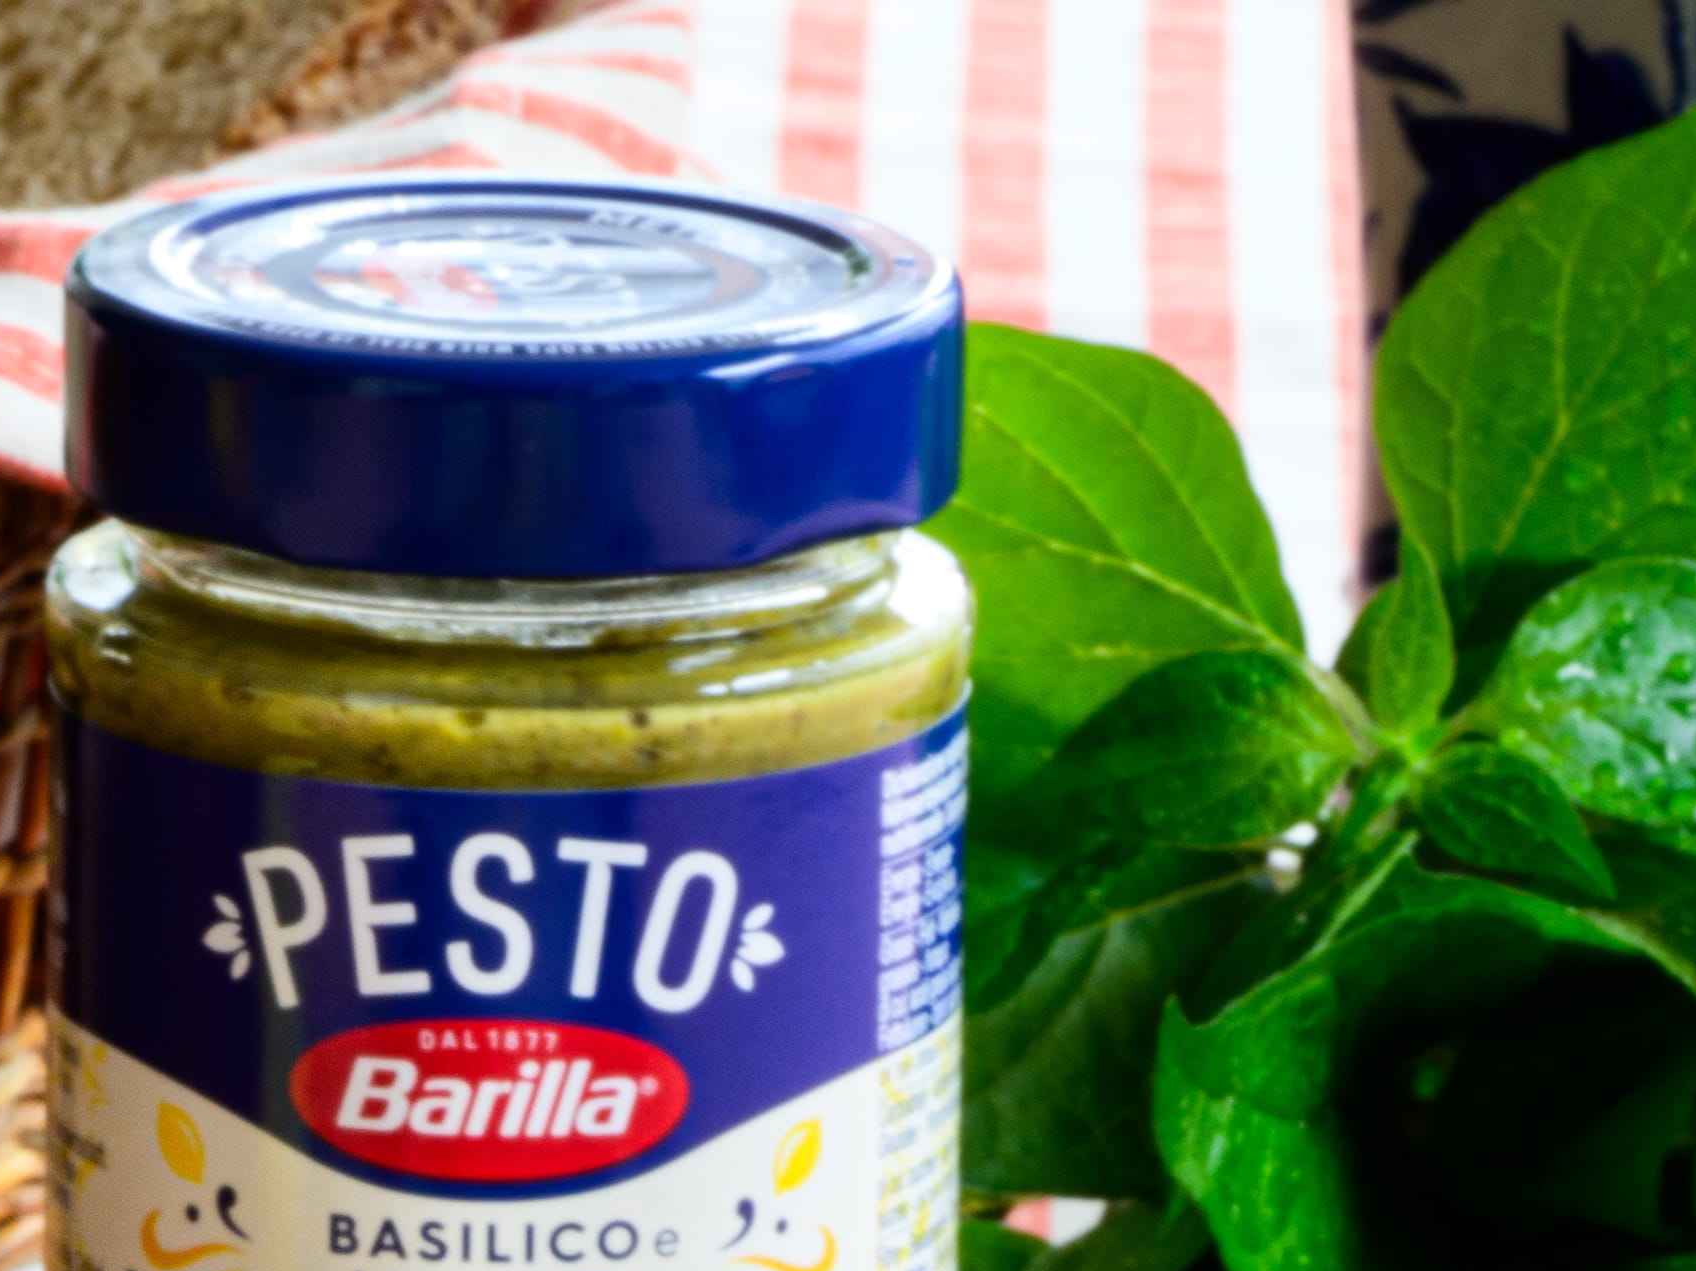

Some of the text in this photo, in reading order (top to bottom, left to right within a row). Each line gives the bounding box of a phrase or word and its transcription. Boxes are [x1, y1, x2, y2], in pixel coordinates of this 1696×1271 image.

[240, 832, 741, 1012] PESTO
[418, 1028, 560, 1052] DAL 1877
[337, 1056, 638, 1139] Barilla
[329, 1213, 681, 1263] BASILICO e
